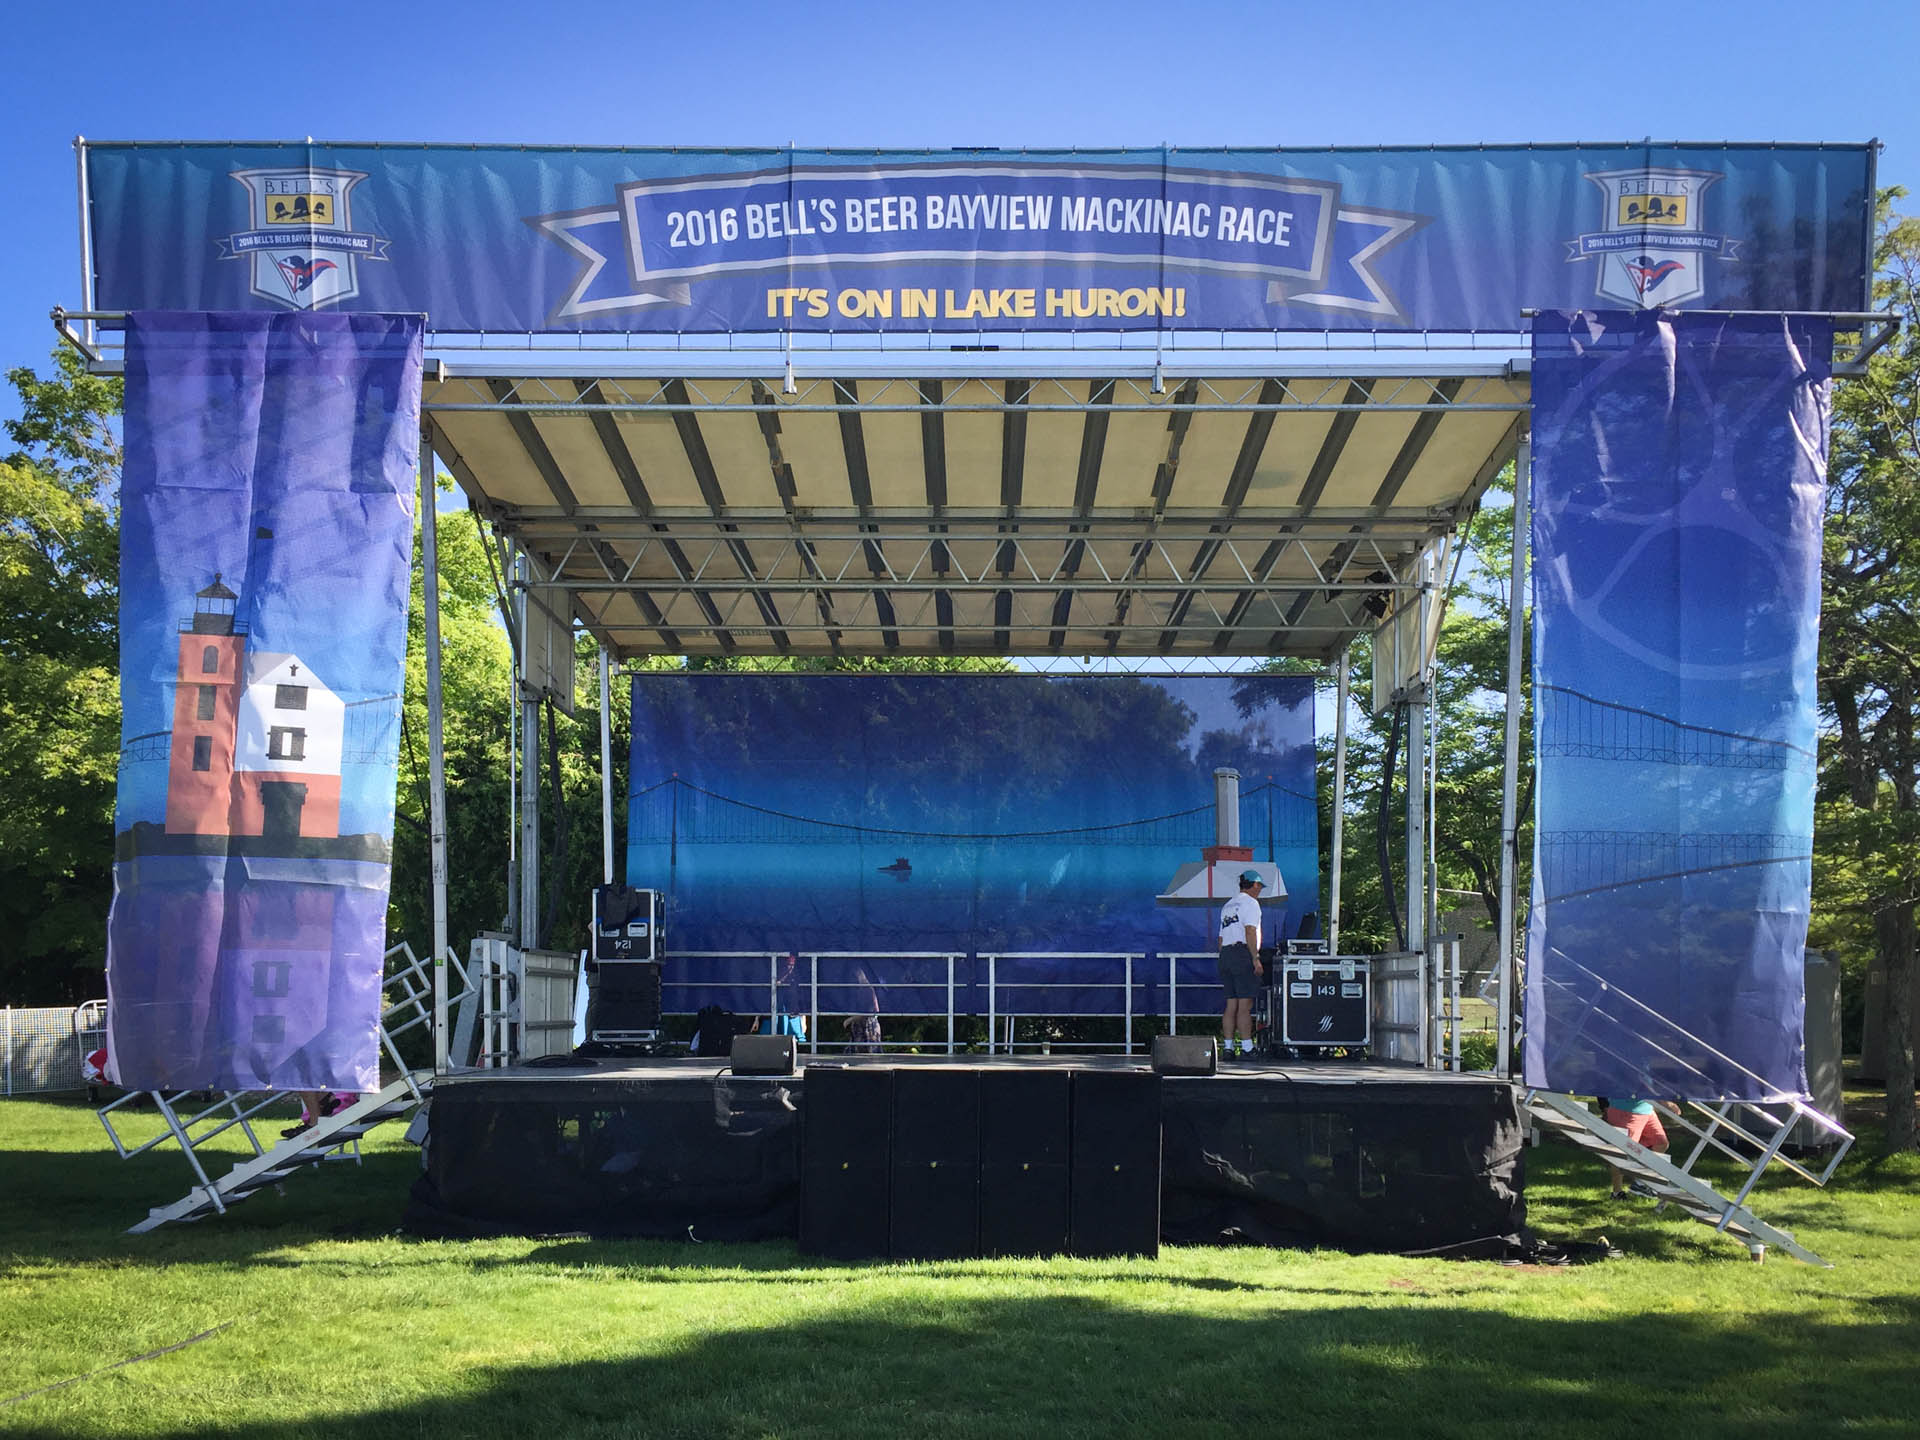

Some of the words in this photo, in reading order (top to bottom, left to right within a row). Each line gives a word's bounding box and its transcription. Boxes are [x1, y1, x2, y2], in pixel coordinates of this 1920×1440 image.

[265, 180, 334, 193] BELL'S
[1619, 180, 1689, 194] BELL'S
[667, 208, 739, 248] 2016
[745, 198, 838, 240] BELL'S
[845, 196, 918, 233] BEER
[926, 194, 1053, 231] BAYVIEW
[1060, 196, 1212, 238] MACKINAC
[1217, 205, 1293, 247] RACE
[238, 238, 254, 248] 2016
[254, 235, 274, 246] BELL'S
[275, 234, 291, 244] BEER
[318, 234, 352, 247] MACKINAC
[352, 238, 368, 248] RACE
[1588, 238, 1604, 248] 2016
[767, 288, 829, 318] IT'S
[837, 288, 893, 318] ON
[901, 288, 937, 318] IN
[945, 288, 1036, 318] LAKE
[1045, 287, 1186, 318] HURON!
[1317, 985, 1336, 996] 143
